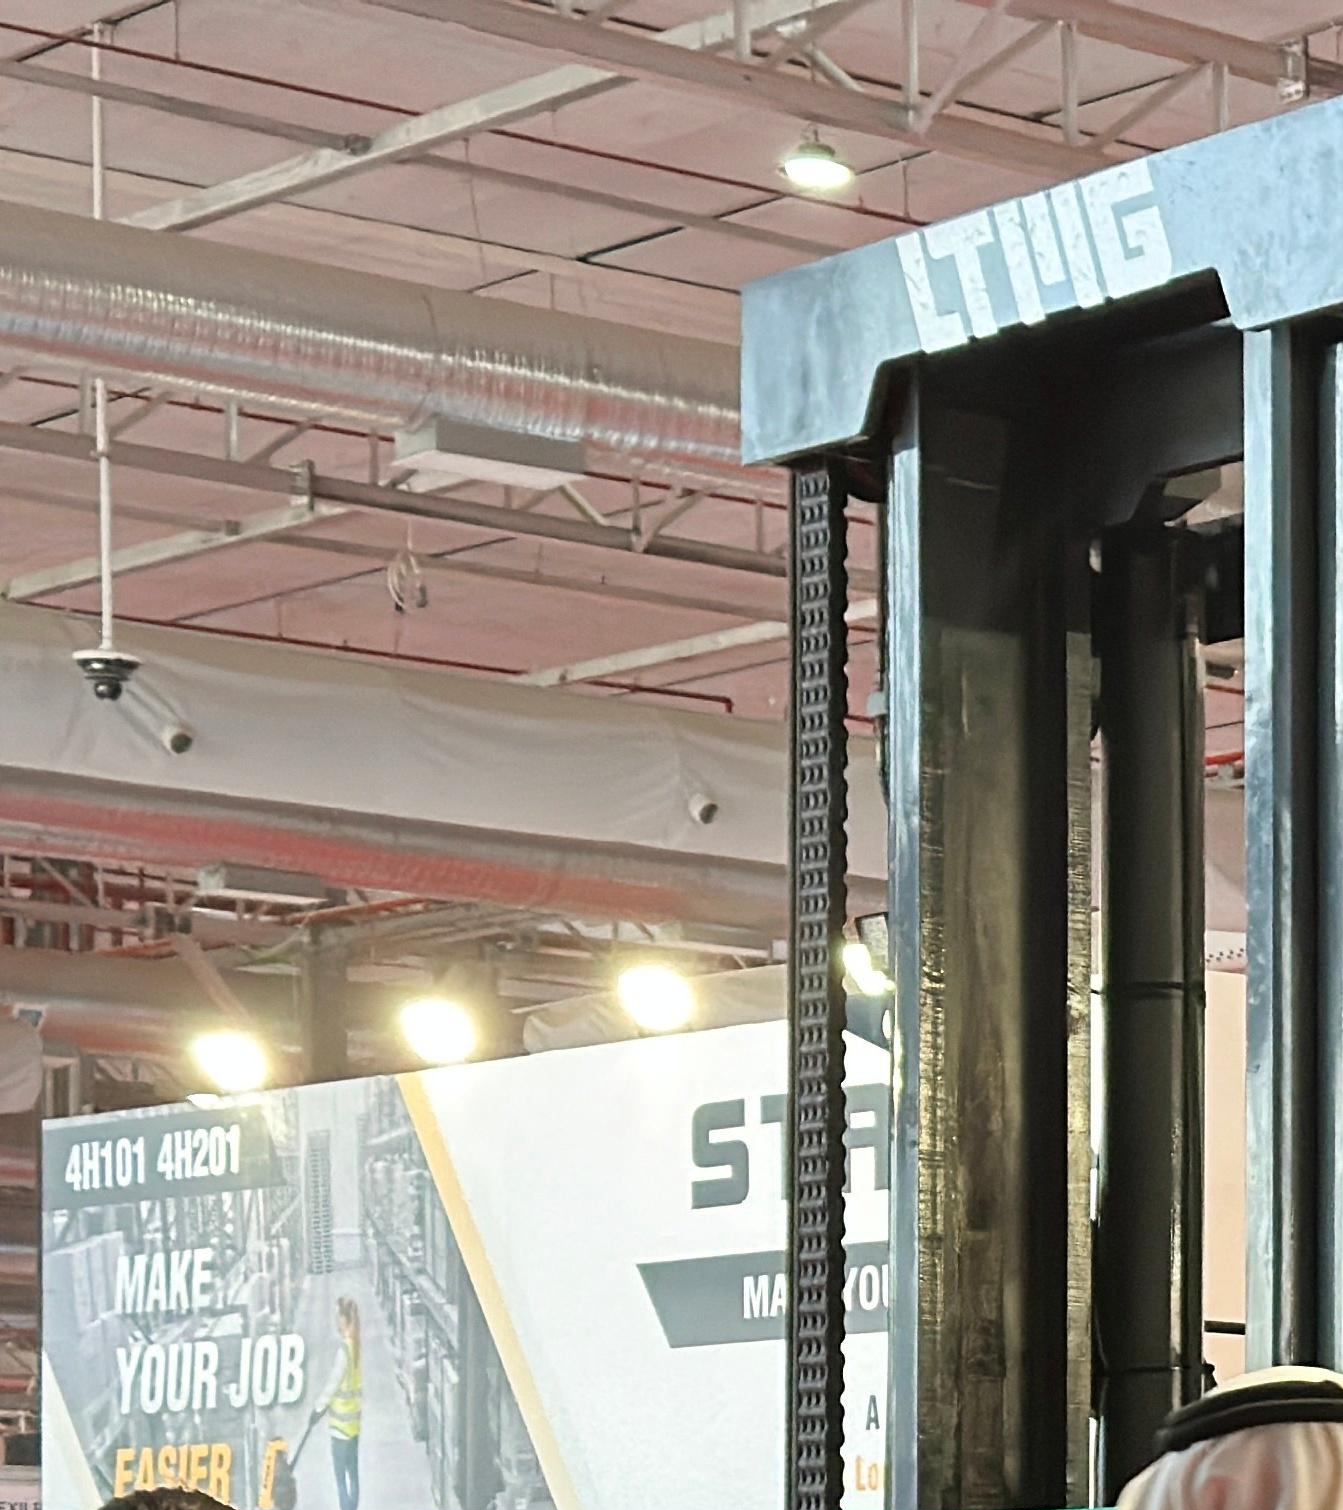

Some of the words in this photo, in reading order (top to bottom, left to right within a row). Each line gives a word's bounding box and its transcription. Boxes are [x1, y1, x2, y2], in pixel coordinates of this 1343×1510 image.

[895, 158, 1172, 354] LTMG
[65, 1136, 145, 1191] 4H101
[157, 1123, 241, 1181] 4H201
[115, 1247, 213, 1315] MAKE
[117, 1339, 218, 1415] YOUR
[229, 1334, 305, 1409] JOB
[114, 1443, 232, 1505] EASIER
